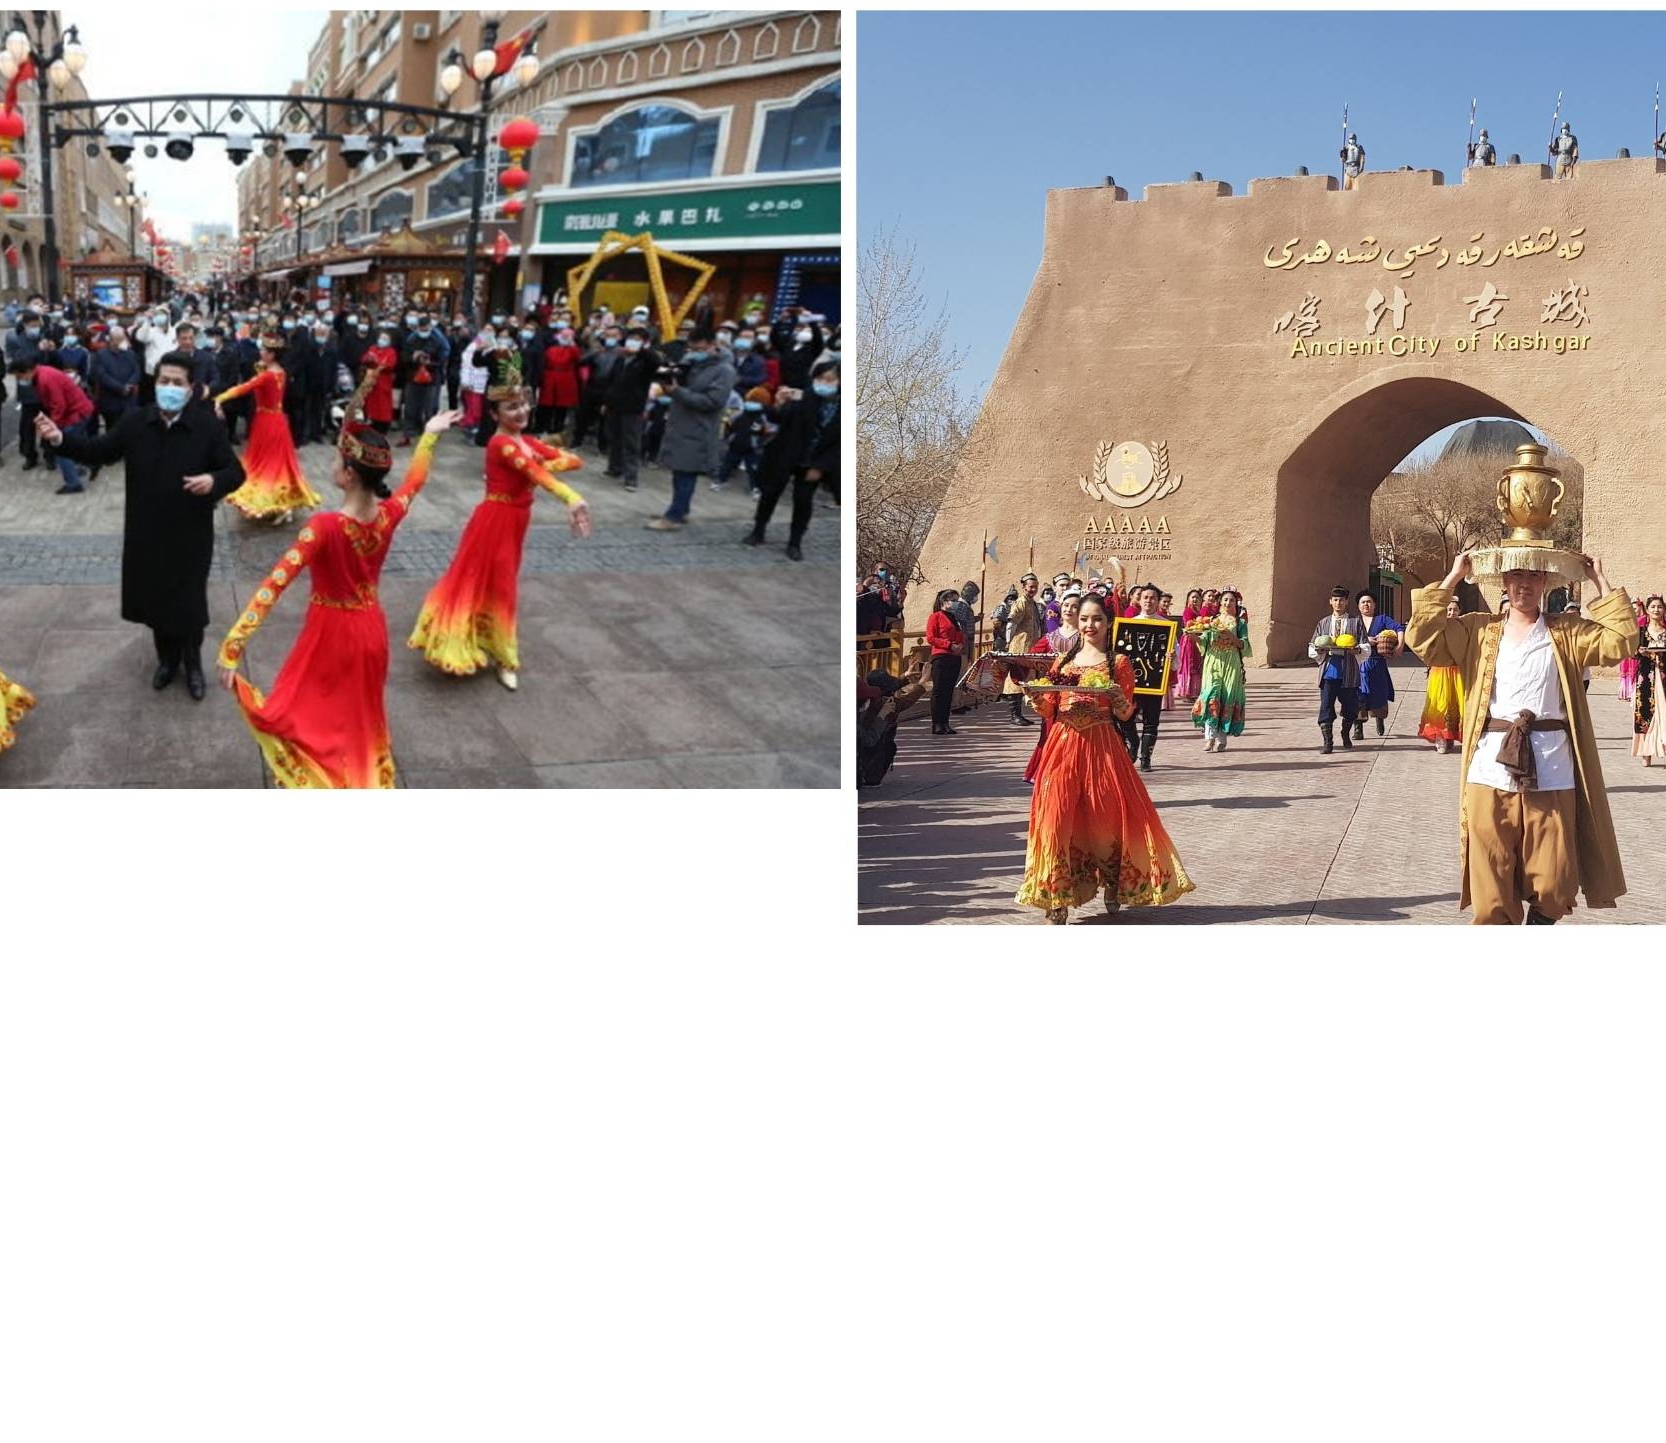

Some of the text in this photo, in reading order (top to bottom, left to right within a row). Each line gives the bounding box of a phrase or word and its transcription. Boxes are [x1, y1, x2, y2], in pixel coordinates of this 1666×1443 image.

[634, 206, 723, 228] 水果巴扎
[1273, 277, 1591, 338] 喀什古城
[1291, 330, 1591, 359] Ancient City of Kashgar
[1084, 515, 1172, 534] AAAAA
[1084, 536, 1172, 551] 国家级旅游景区
